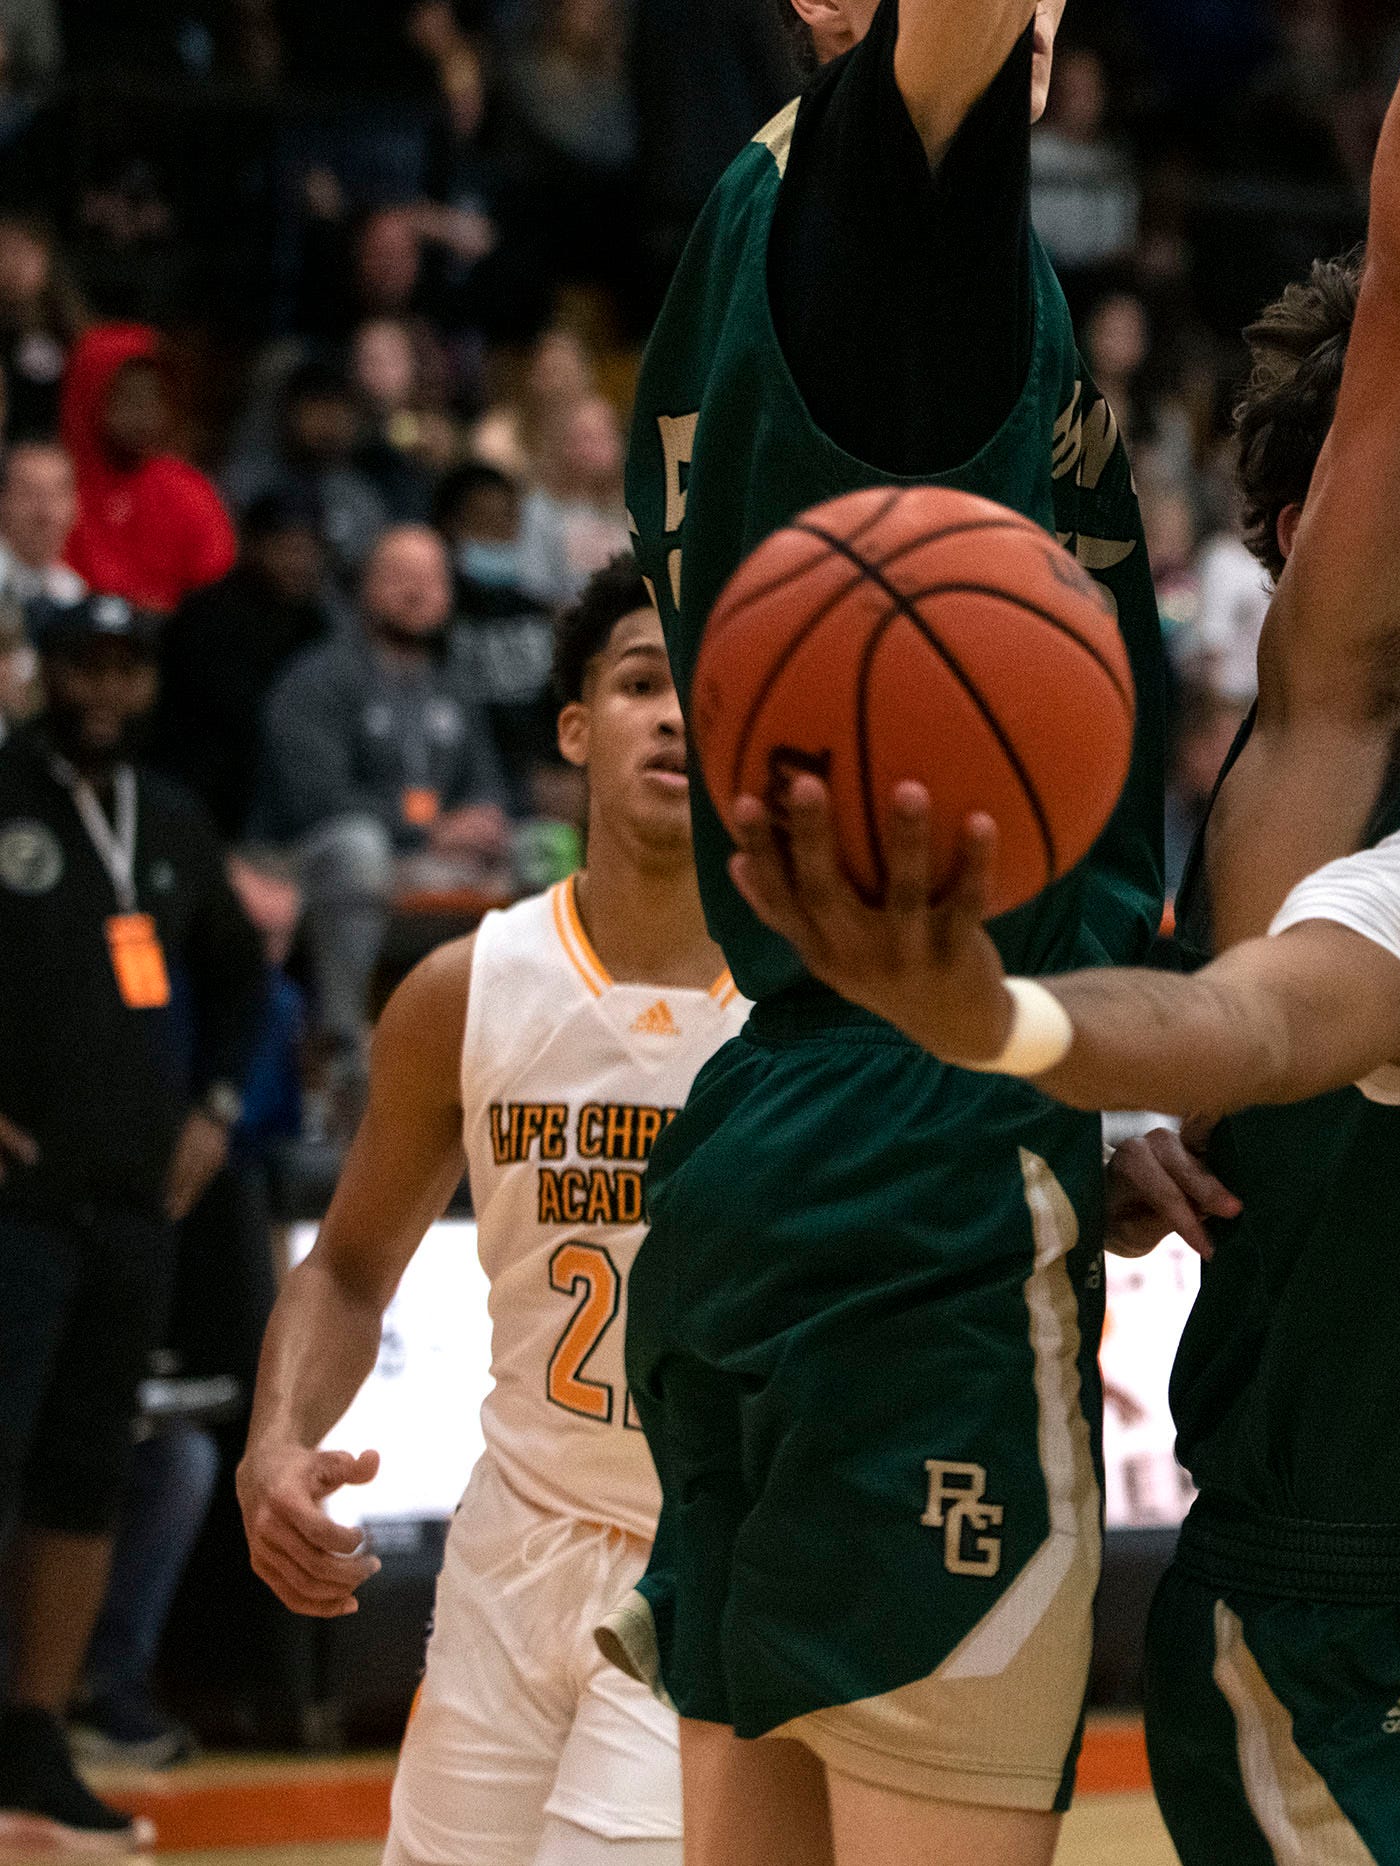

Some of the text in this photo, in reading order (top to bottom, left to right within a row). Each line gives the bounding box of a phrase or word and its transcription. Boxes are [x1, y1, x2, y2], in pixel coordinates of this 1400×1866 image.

[490, 1100, 568, 1165] LIFE
[538, 1167, 650, 1226] ACAD
[547, 1240, 642, 1432] 2
